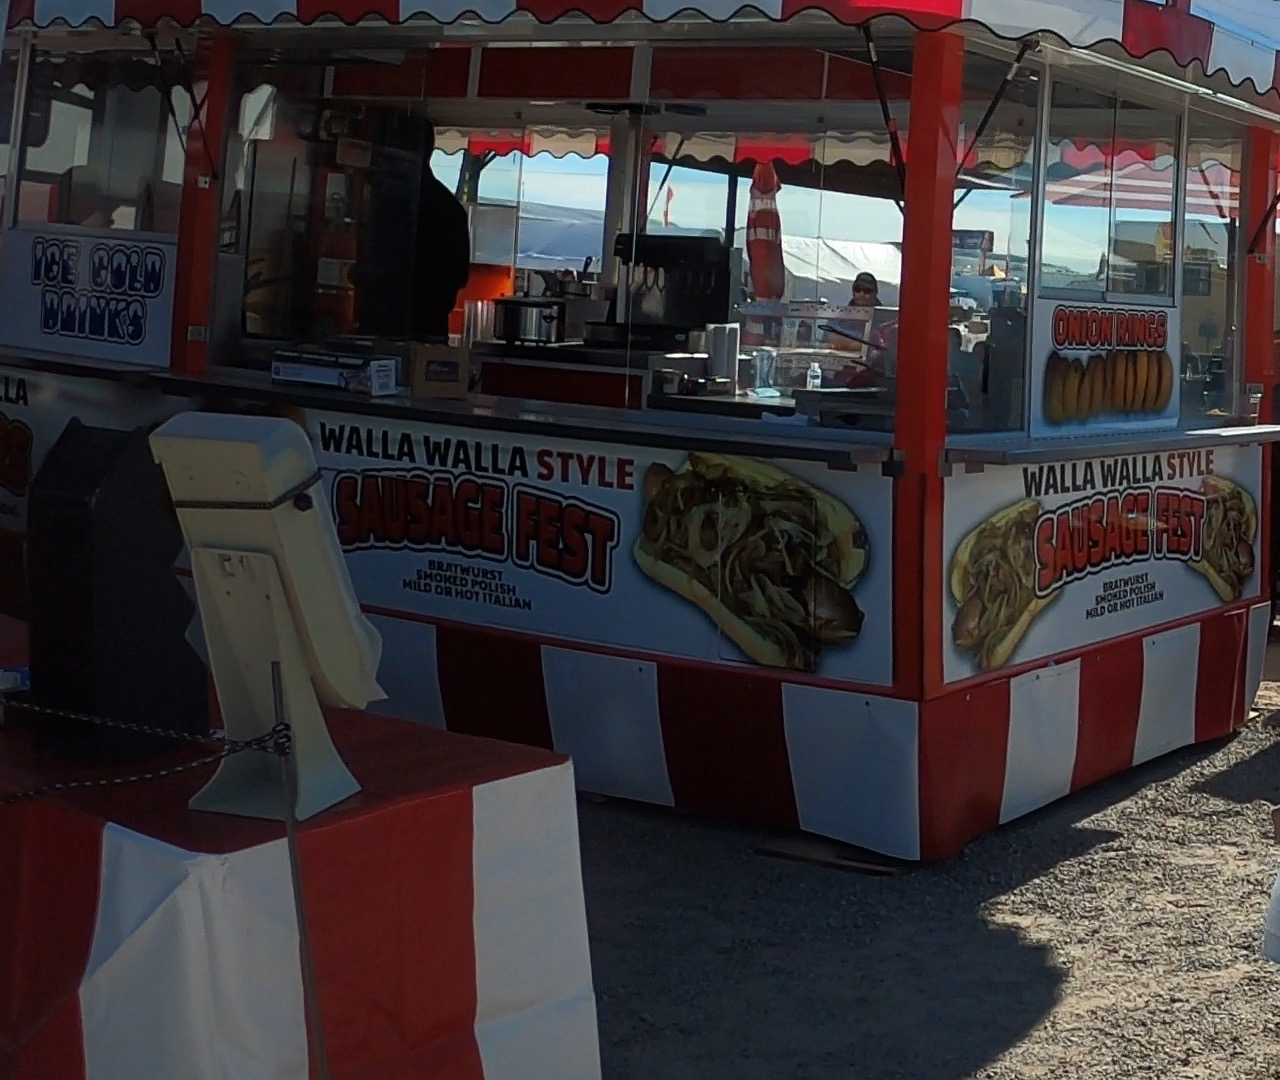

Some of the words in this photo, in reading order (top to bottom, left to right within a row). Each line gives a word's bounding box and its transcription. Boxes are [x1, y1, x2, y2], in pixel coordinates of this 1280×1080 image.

[32, 236, 80, 287] ICE
[91, 243, 165, 298] COLD
[41, 285, 147, 346] DRINKS
[1052, 305, 1115, 351] ONION
[1115, 309, 1168, 351] RINGS
[320, 422, 415, 463] WALLA
[424, 435, 528, 478] WALLA
[537, 448, 635, 491] STYLE
[1023, 459, 1096, 498] WALLA
[1100, 454, 1164, 487] WALLA
[1167, 449, 1214, 480] STYLE
[332, 468, 510, 562] SAUSAGE
[511, 482, 621, 595] FEST
[1034, 486, 1152, 598] SAUSAGE
[1152, 486, 1207, 561] FEST
[416, 569, 468, 588] SMOKED
[471, 578, 517, 596] POLISH
[428, 559, 504, 581] BRATWURST
[1103, 572, 1149, 593] BRATWURST
[402, 579, 432, 593] MILD
[434, 584, 453, 597] OR
[455, 587, 479, 602] HOT
[482, 593, 532, 610] ITALIAN
[1086, 605, 1106, 620] MILD
[1107, 602, 1118, 614] OR
[1120, 598, 1135, 611] HOT
[1136, 590, 1164, 607] ITALIAN
[1095, 588, 1129, 606] SMOKED
[1129, 581, 1156, 597] POLISH
